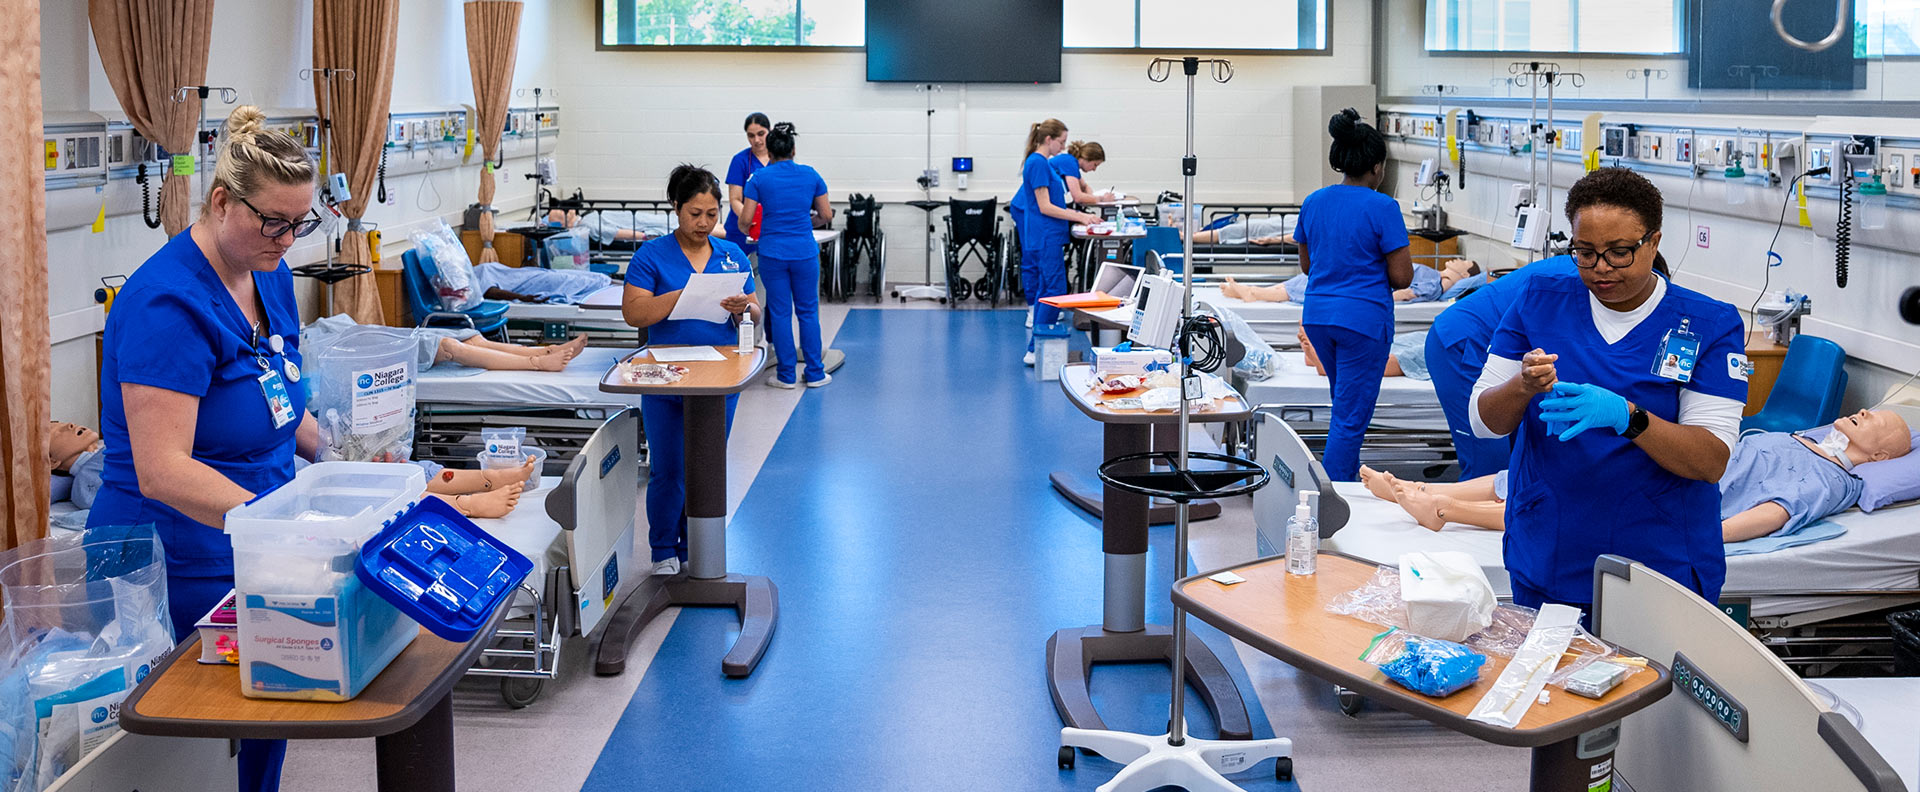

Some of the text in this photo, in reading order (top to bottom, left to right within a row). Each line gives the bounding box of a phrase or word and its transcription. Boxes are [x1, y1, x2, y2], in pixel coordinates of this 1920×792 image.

[1680, 360, 1691, 368] nc
[374, 367, 404, 380] Niagara
[374, 375, 404, 387] College
[254, 635, 320, 646] Surgical Sponges
[137, 670, 149, 679] nc
[93, 709, 105, 719] nc
